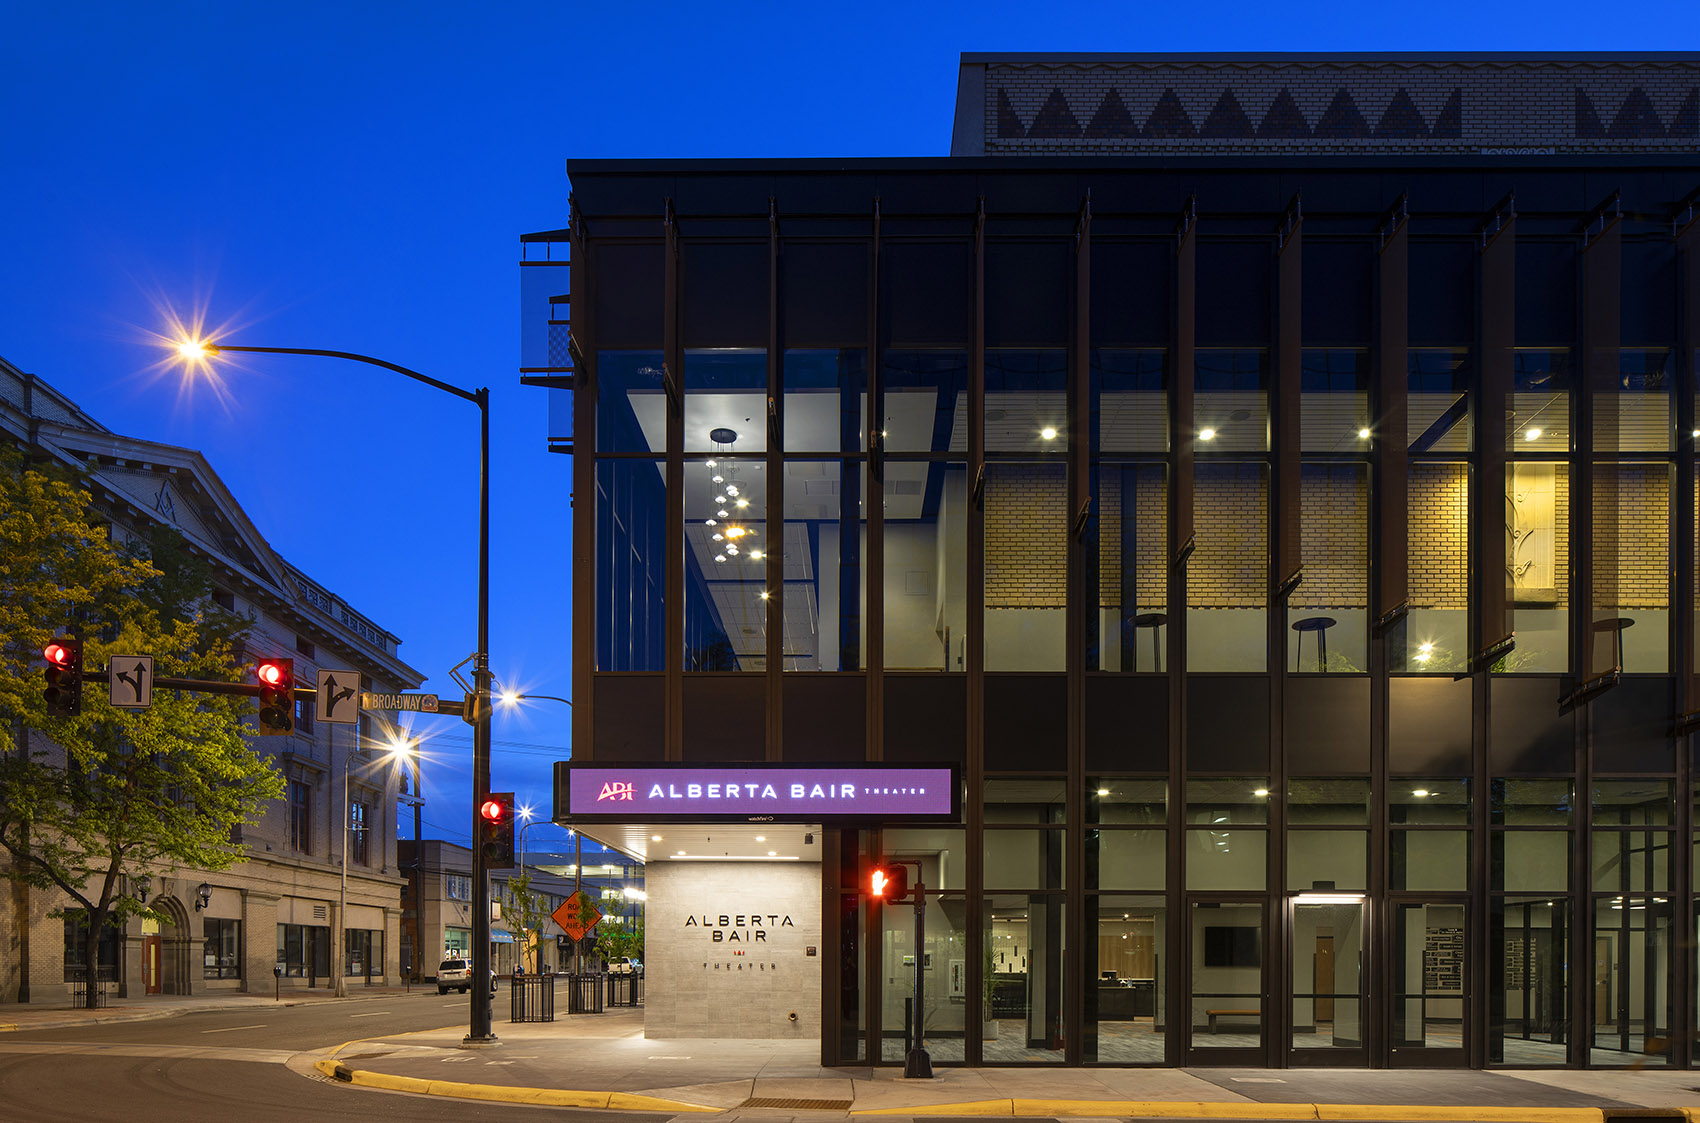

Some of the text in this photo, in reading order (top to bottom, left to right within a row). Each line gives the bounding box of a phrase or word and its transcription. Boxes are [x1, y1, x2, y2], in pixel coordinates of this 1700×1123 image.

[372, 694, 421, 710] BROADWAY
[648, 783, 926, 799] ALBERTA BAIR THEATER
[685, 914, 794, 928] ALBERTA
[712, 930, 767, 942] BAIR
[703, 962, 776, 971] THEATER
